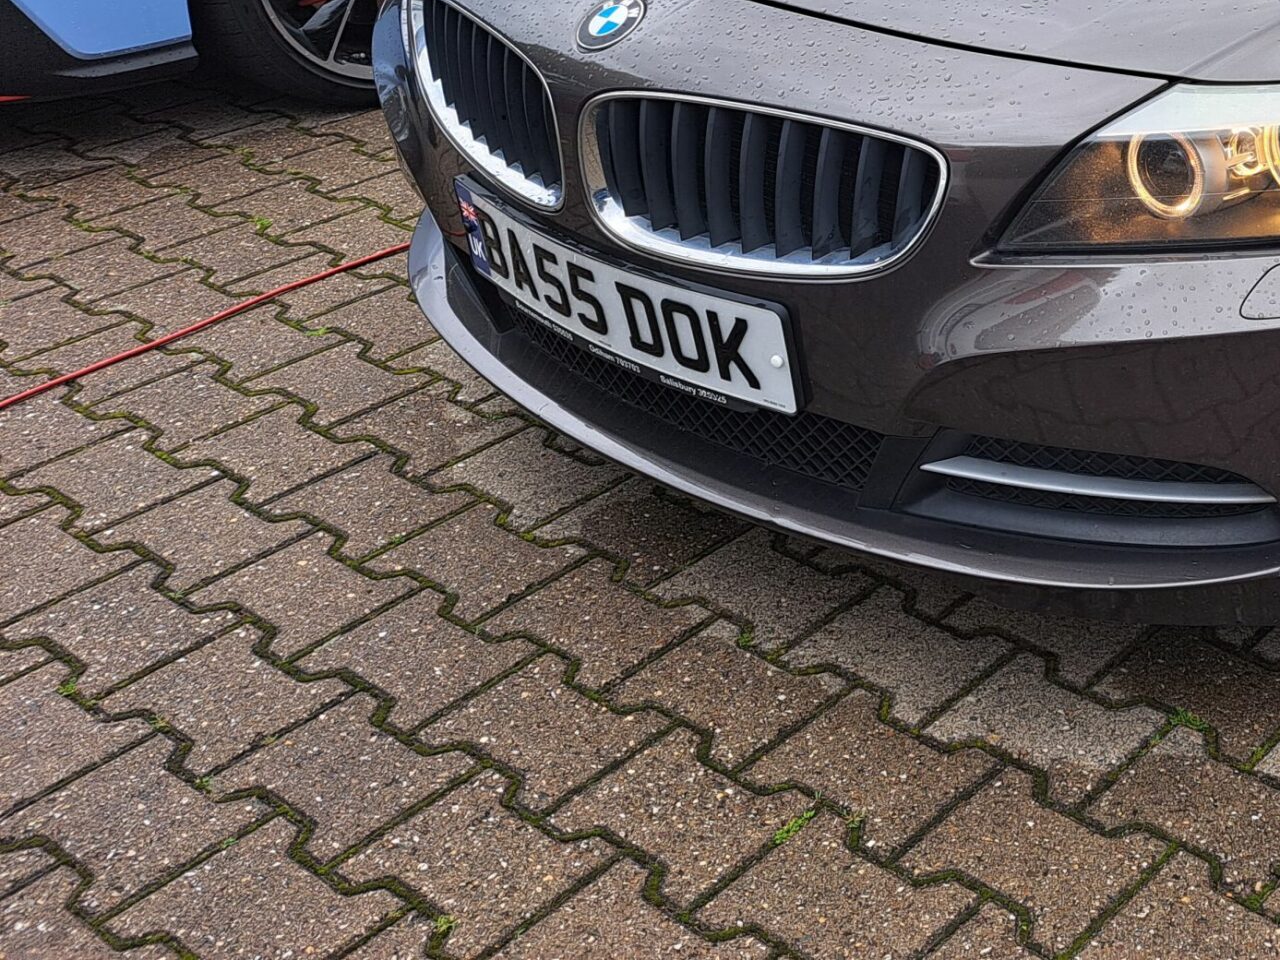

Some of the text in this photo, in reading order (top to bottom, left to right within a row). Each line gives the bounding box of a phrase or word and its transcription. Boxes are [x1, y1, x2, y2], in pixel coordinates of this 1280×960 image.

[468, 232, 487, 262] UK
[614, 281, 761, 390] DOK
[659, 374, 696, 396] Salisbury
